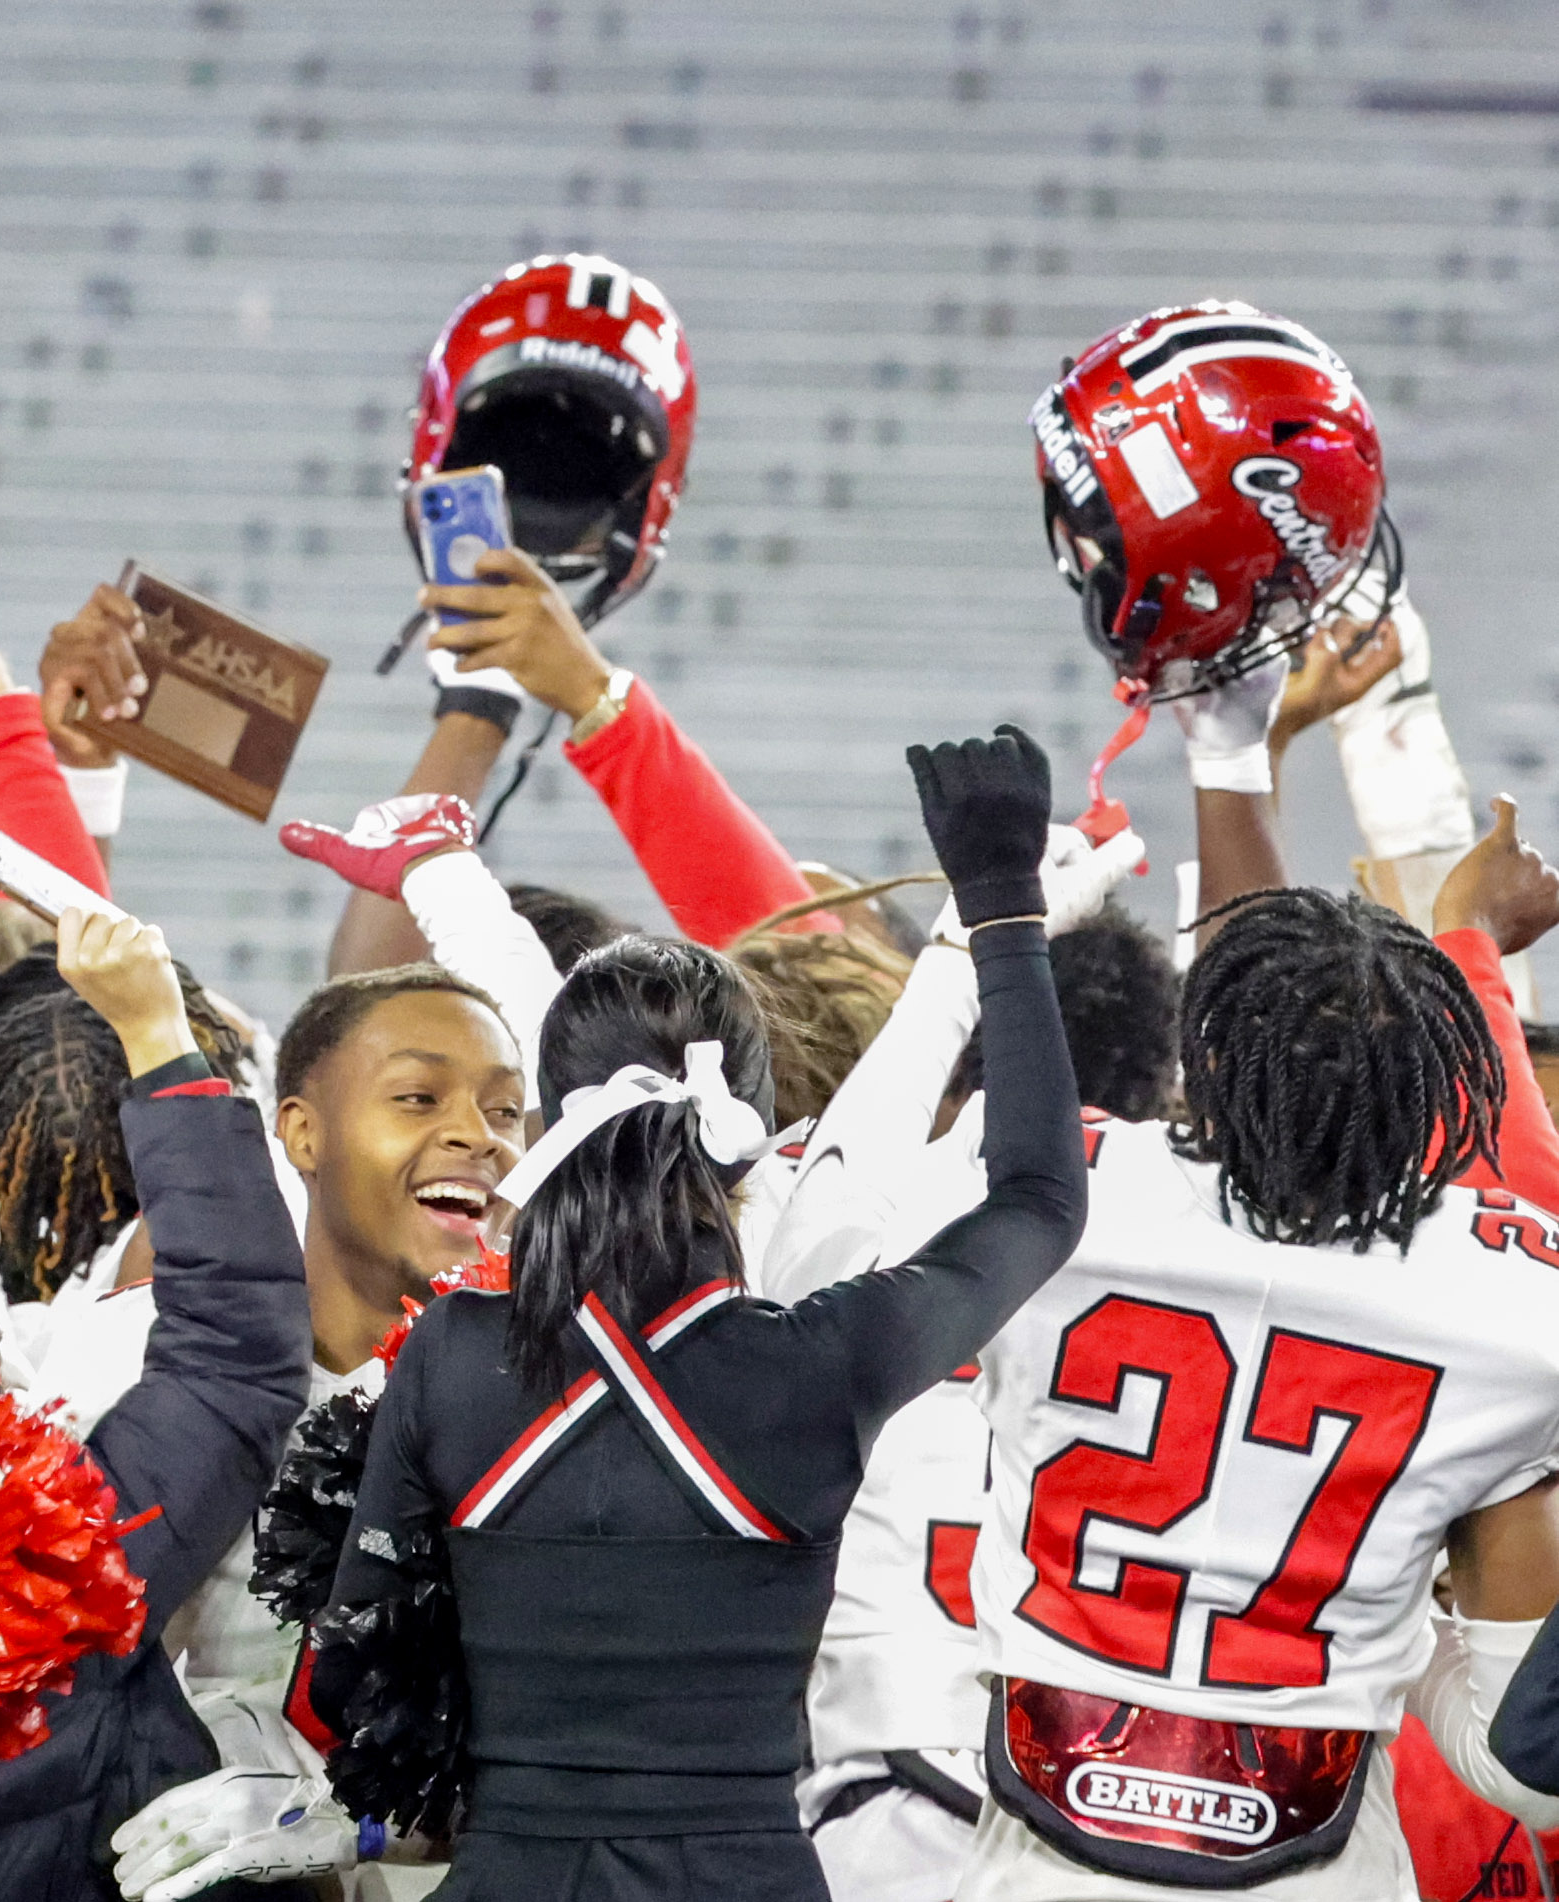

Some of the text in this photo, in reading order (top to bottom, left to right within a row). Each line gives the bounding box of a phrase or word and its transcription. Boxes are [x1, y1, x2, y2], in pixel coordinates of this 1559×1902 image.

[1231, 456, 1349, 588] Central
[178, 634, 295, 718] AHSAA
[1015, 1293, 1445, 1688] 27
[1085, 1773, 1258, 1833] BATTLE
